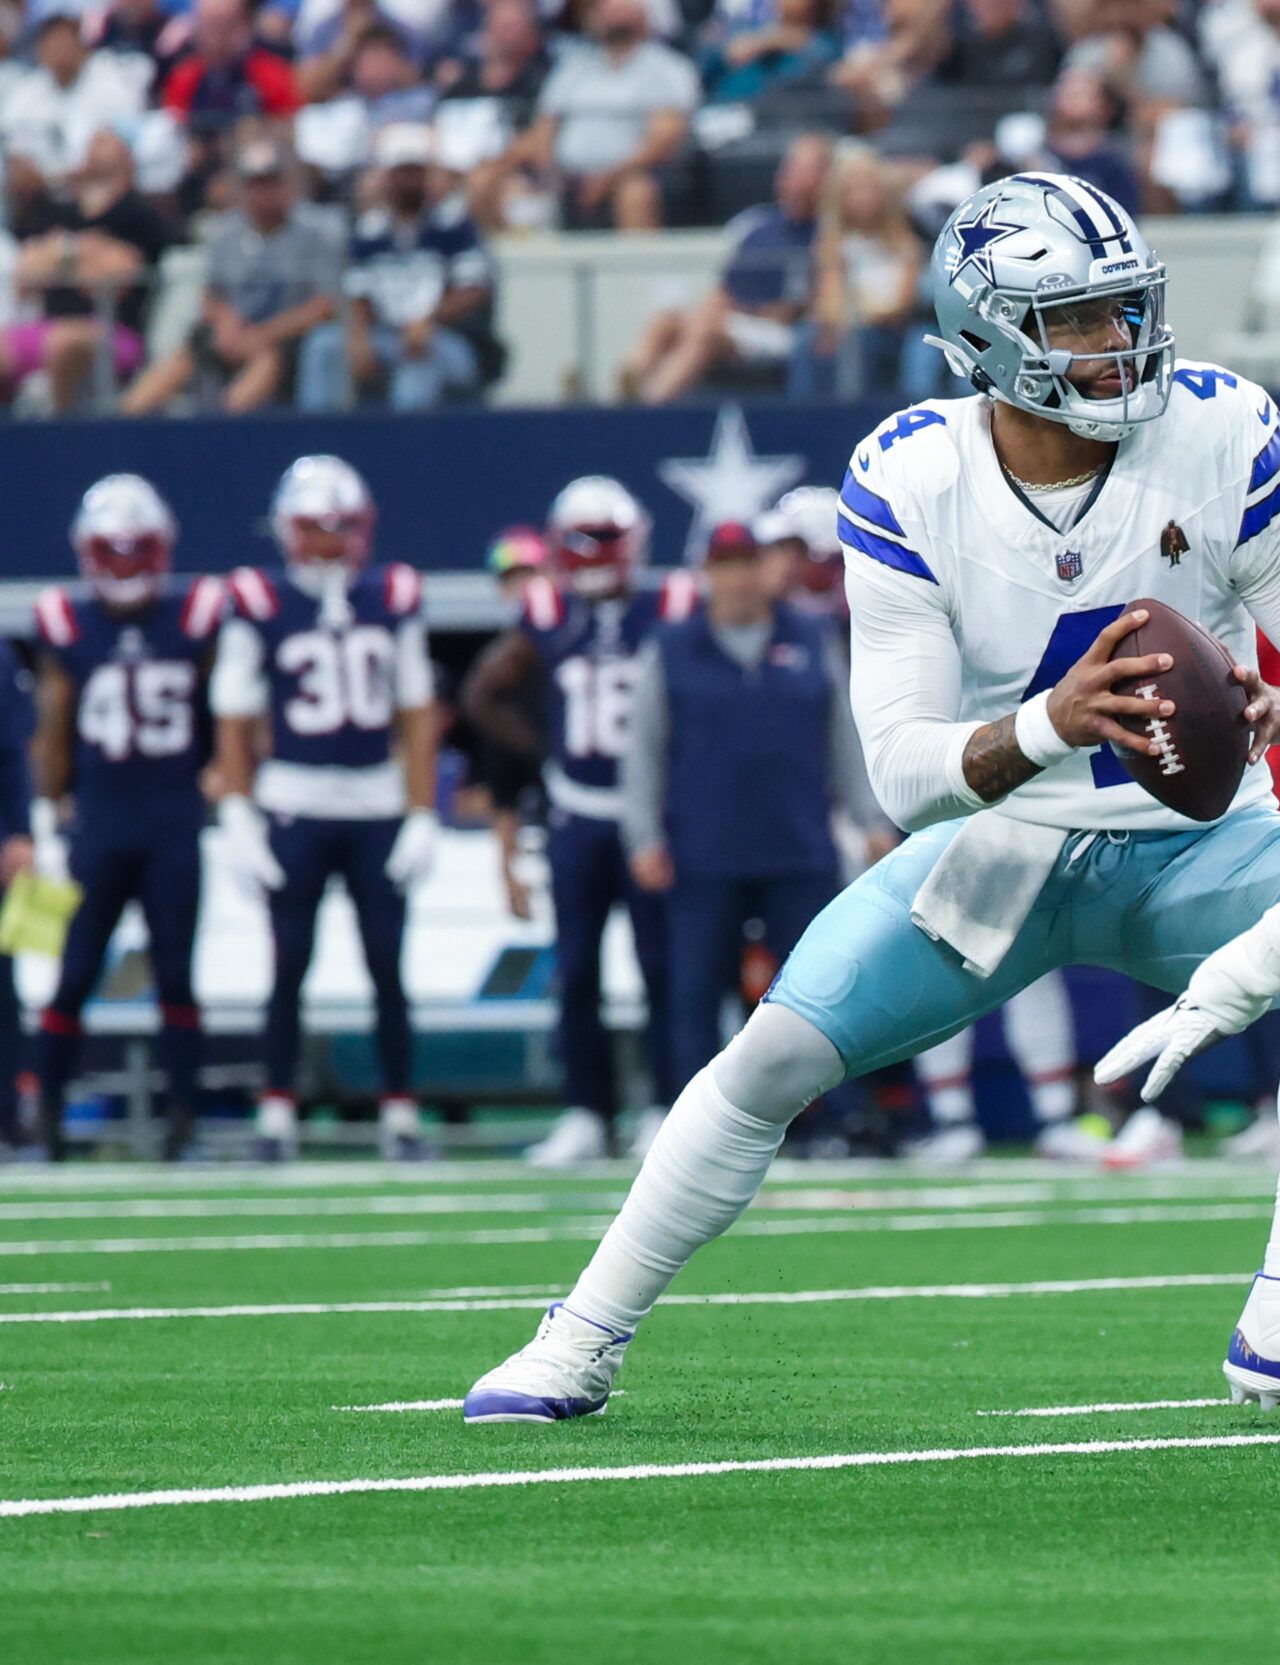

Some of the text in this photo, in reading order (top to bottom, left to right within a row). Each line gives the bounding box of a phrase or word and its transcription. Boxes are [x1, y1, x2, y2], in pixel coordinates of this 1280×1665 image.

[1101, 259, 1139, 274] COWBOYS
[1173, 369, 1237, 400] 4
[878, 410, 947, 453] 4
[275, 624, 396, 735] 30
[77, 659, 196, 762] 45
